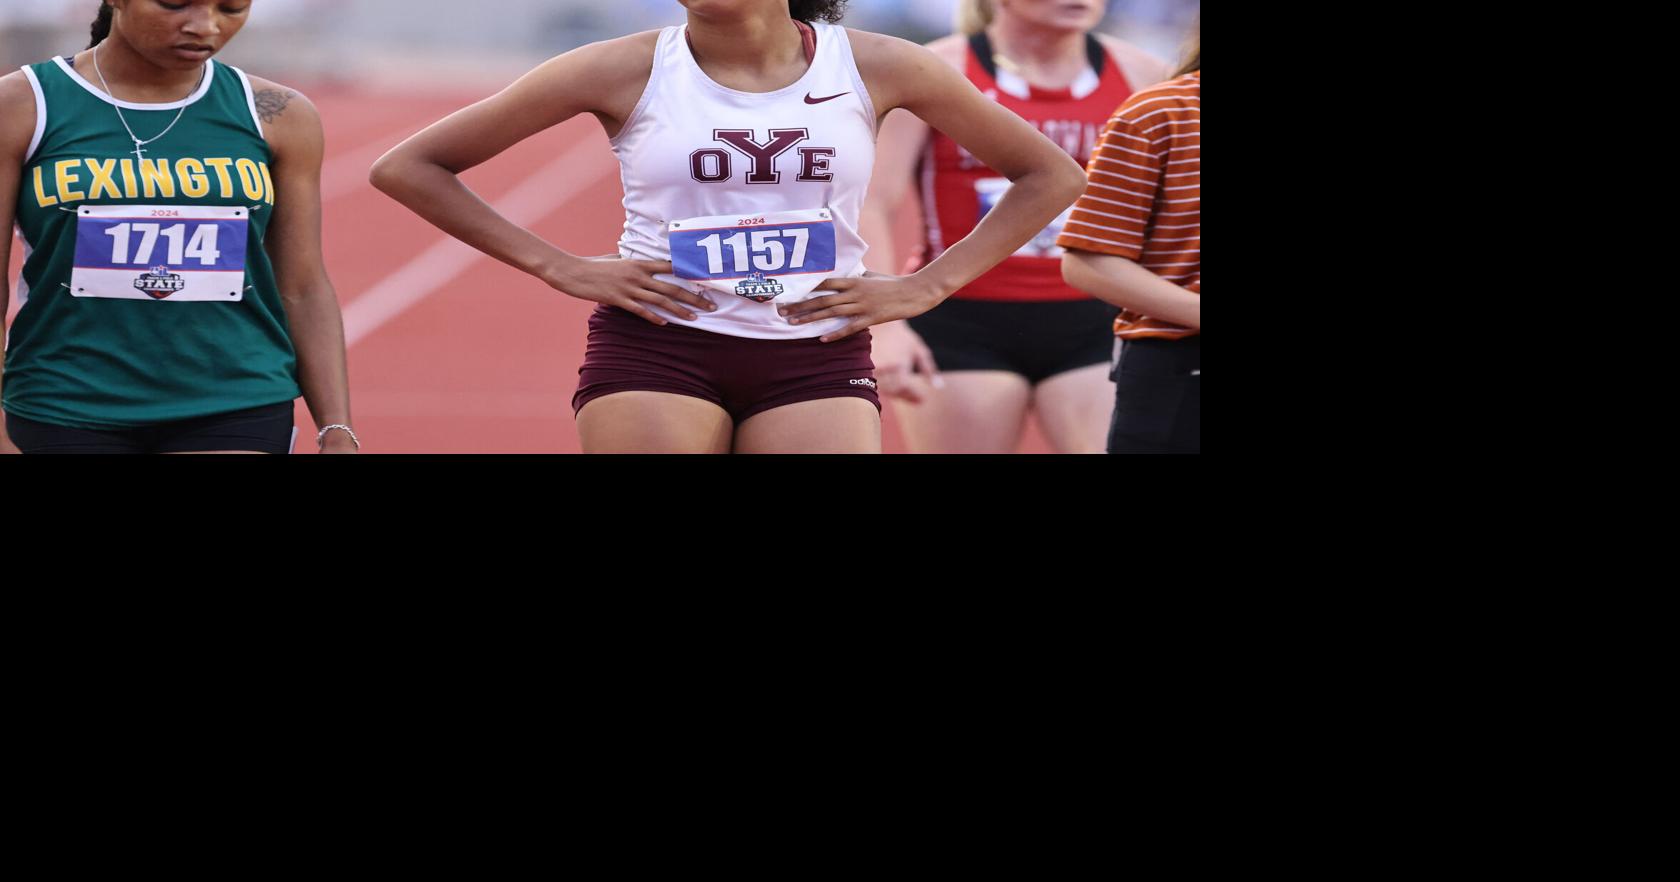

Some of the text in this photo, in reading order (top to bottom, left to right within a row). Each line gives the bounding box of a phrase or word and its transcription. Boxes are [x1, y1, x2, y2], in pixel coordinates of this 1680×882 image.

[689, 128, 836, 184] OYE
[151, 208, 179, 217] 2024
[737, 217, 766, 226] 2024
[104, 222, 221, 265] 1714
[696, 228, 809, 274] 1157
[134, 279, 184, 289] STATE
[736, 284, 783, 295] STATE
[849, 378, 876, 389] adida
